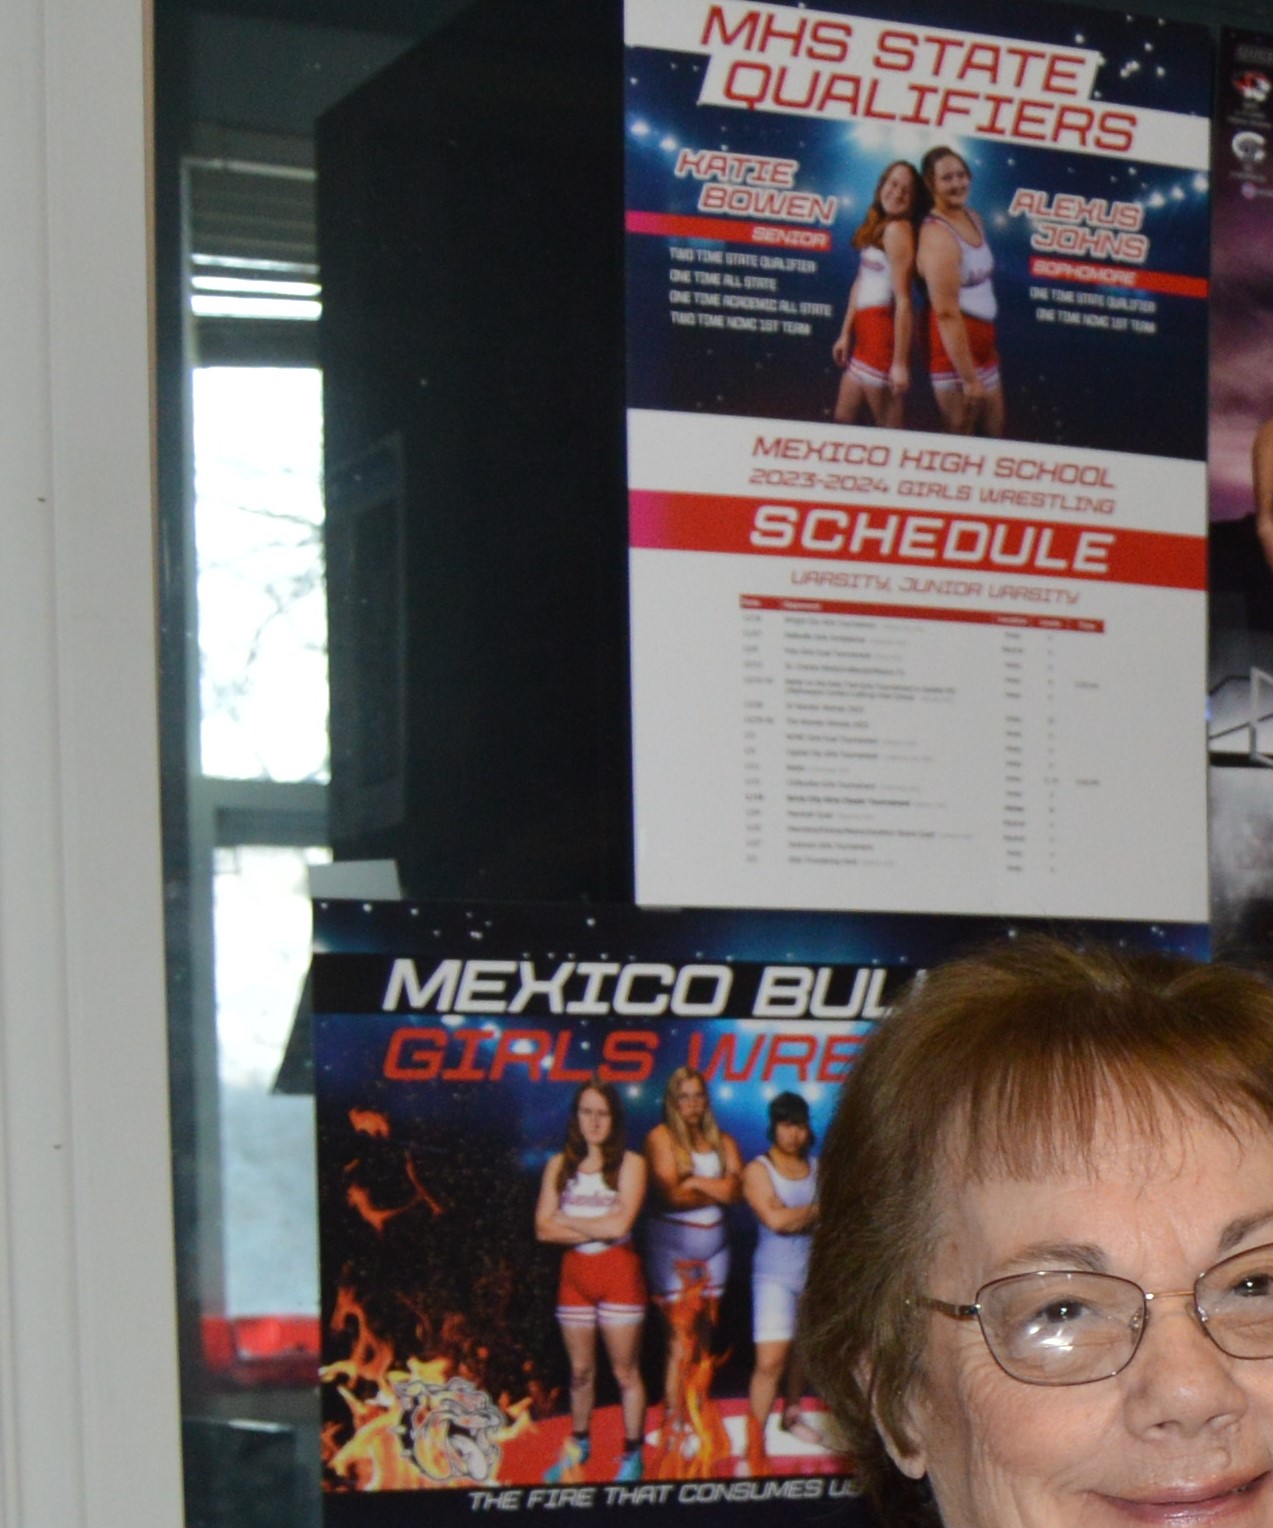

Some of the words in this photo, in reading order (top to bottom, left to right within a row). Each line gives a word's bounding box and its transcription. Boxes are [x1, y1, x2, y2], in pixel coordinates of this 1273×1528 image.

[702, 6, 853, 63] MHS
[873, 29, 1086, 96] STATE
[723, 60, 1137, 152] QUALIFIERS
[676, 150, 798, 187] KATIE
[699, 183, 837, 224] BOWEN
[1009, 188, 1143, 232] ALEXUS
[752, 227, 828, 247] SENIOR
[1031, 222, 1149, 264] JOHNS
[752, 436, 890, 467] MEXICO
[900, 446, 986, 476] HIGH
[994, 456, 1115, 488] SCHOOL
[749, 468, 890, 495] 2023-2024
[897, 479, 973, 501] GIRLS
[979, 487, 1115, 515] WRESTLING
[750, 505, 1115, 574] SCHEDULE
[898, 576, 983, 597] JUNIOR
[987, 583, 1079, 605] VARSITY
[382, 958, 734, 1017] MEXICO
[382, 1027, 661, 1083] GIRLS
[687, 1031, 870, 1083] WRE
[469, 1490, 523, 1512] THE
[526, 1486, 596, 1509] FIRE
[604, 1483, 674, 1506] THAT
[678, 1478, 824, 1504] CONSUMES
